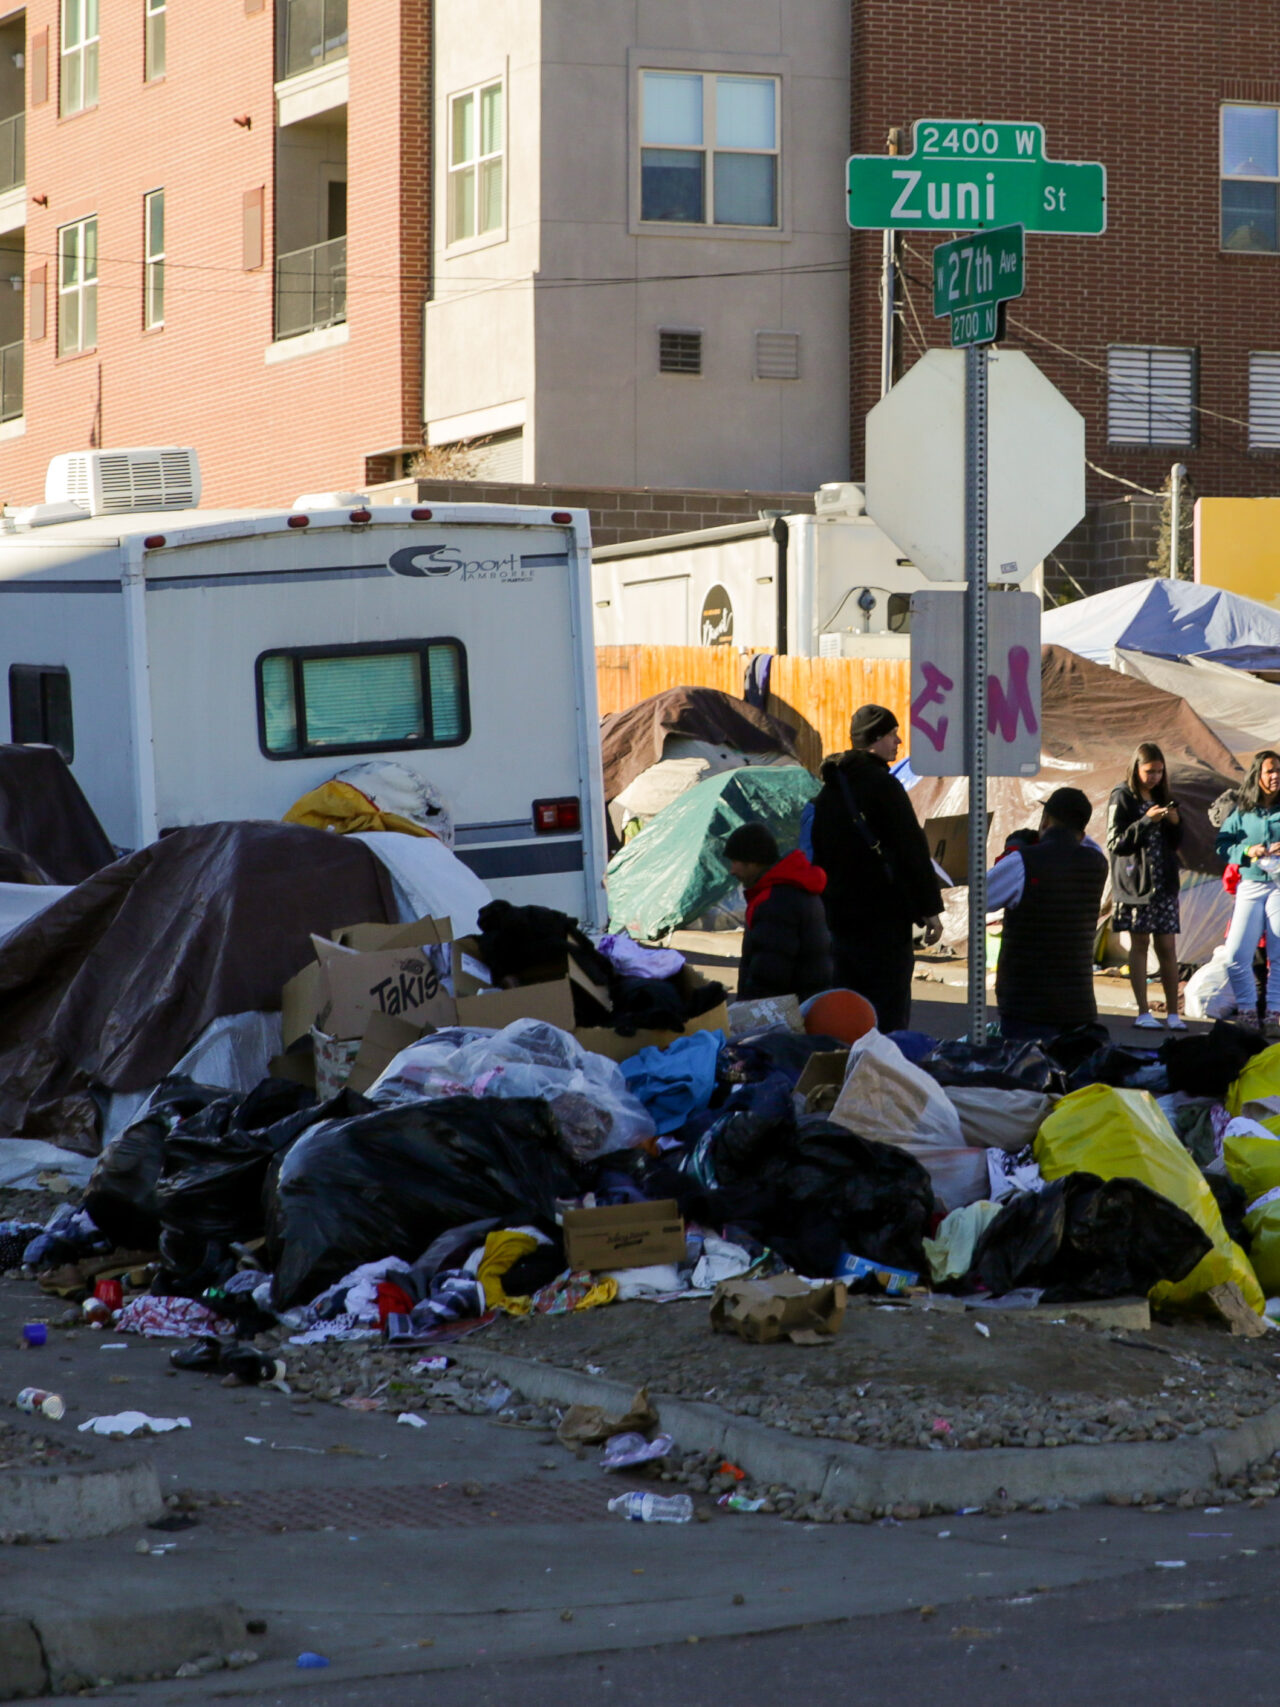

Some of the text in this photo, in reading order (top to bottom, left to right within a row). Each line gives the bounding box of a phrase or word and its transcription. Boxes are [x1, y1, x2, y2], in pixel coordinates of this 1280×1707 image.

[923, 127, 1035, 155] 2400 W
[890, 170, 1067, 220] Zuni St
[937, 245, 1017, 301] W 27th Ave
[954, 308, 993, 341] 2700 N
[369, 968, 439, 1016] Takis
